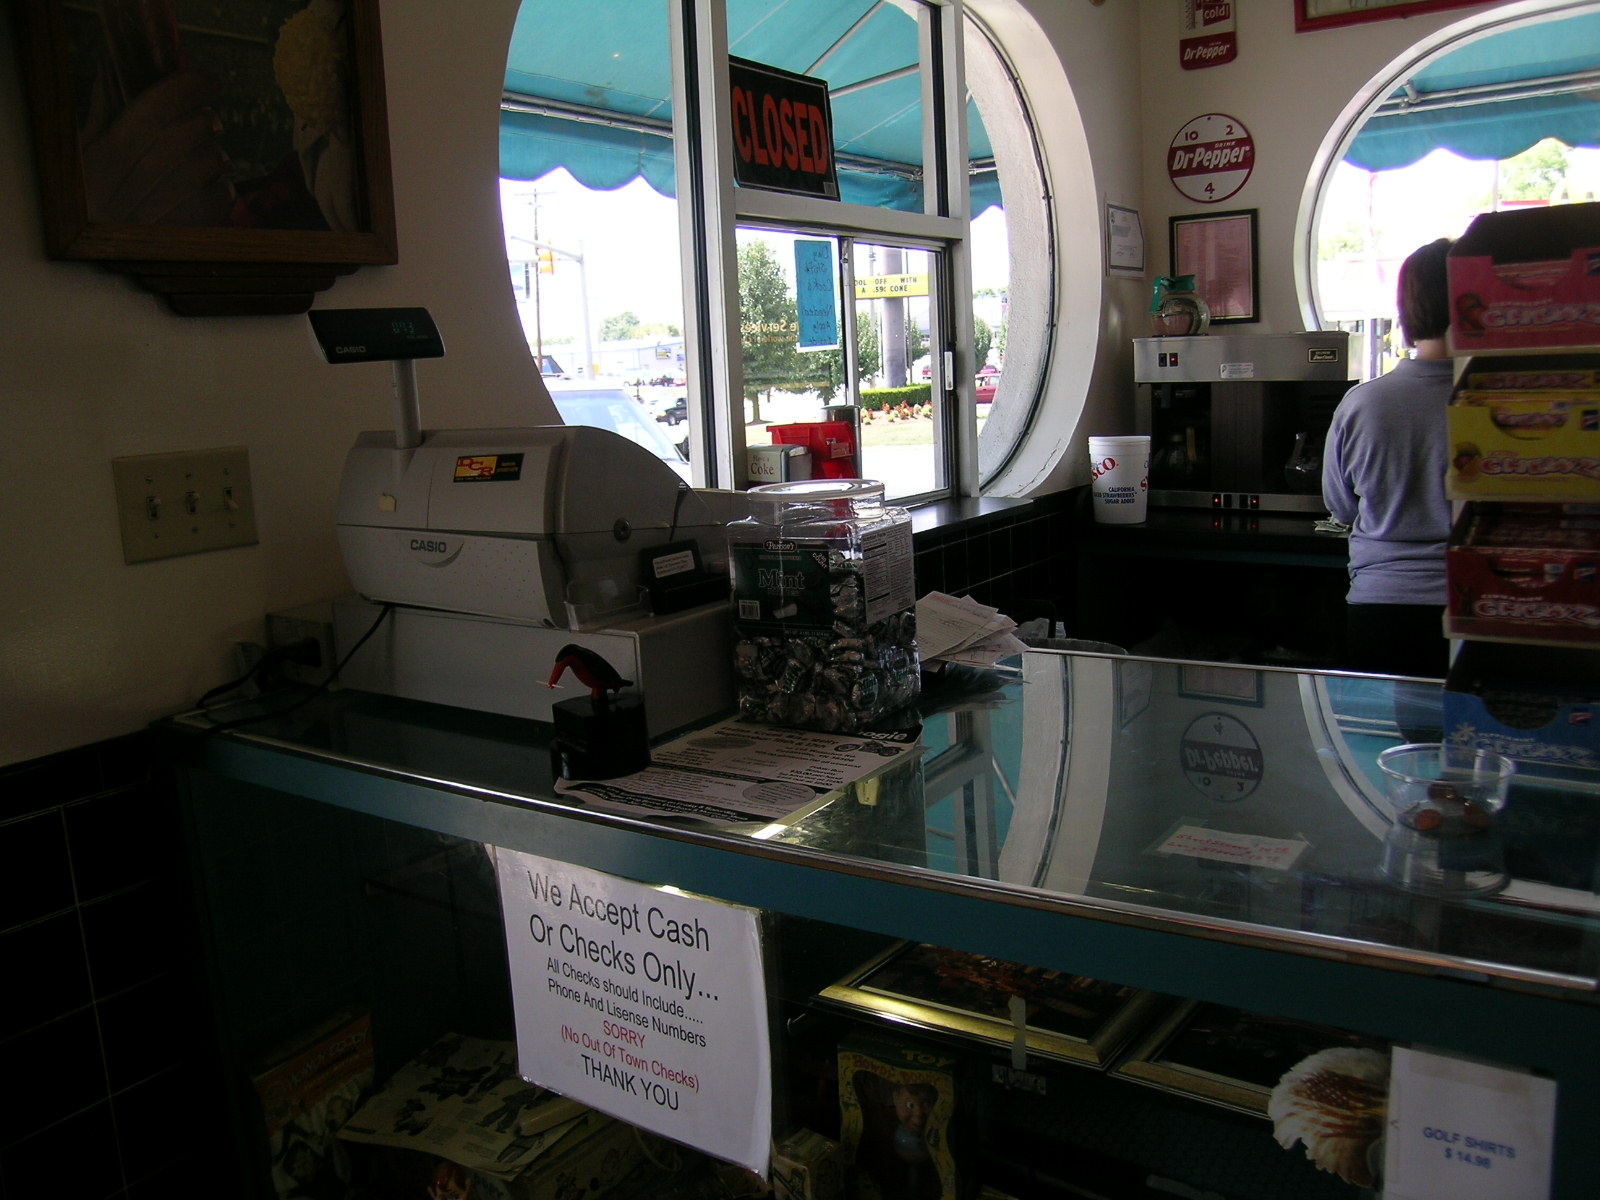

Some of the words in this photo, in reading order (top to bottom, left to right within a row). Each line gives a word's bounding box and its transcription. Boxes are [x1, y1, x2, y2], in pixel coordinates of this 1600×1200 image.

[732, 85, 828, 175] CLOSED
[1185, 130, 1199, 141] 10
[1225, 125, 1234, 136] 2
[1204, 182, 1215, 194] 4
[854, 279, 867, 287] OOL
[335, 346, 367, 354] CASIO
[750, 461, 774, 476] Coke
[410, 539, 447, 553] CASIO
[757, 568, 805, 590] Mint
[527, 870, 562, 907] We
[569, 884, 641, 935] Accept
[647, 907, 709, 951] Cash
[530, 914, 553, 946] Or
[560, 924, 636, 975] Checks
[547, 957, 560, 975] All
[562, 962, 600, 989] Checks
[603, 978, 638, 1001] should
[548, 978, 581, 1003] Phone
[583, 991, 604, 1012] And
[607, 1002, 649, 1028] Lisense
[652, 1016, 707, 1047] Numbers
[603, 1020, 646, 1049] SORRY
[561, 1024, 580, 1044] (No
[581, 1033, 600, 1053] Out
[603, 1040, 616, 1059] Of
[618, 1048, 649, 1073] Town
[651, 1060, 700, 1094] Checks)
[581, 1053, 637, 1096] THANK
[641, 1078, 679, 1111] YOU
[1423, 1126, 1460, 1144] GOLF
[1464, 1136, 1516, 1159] SHIRTS
[1445, 1147, 1452, 1159] $
